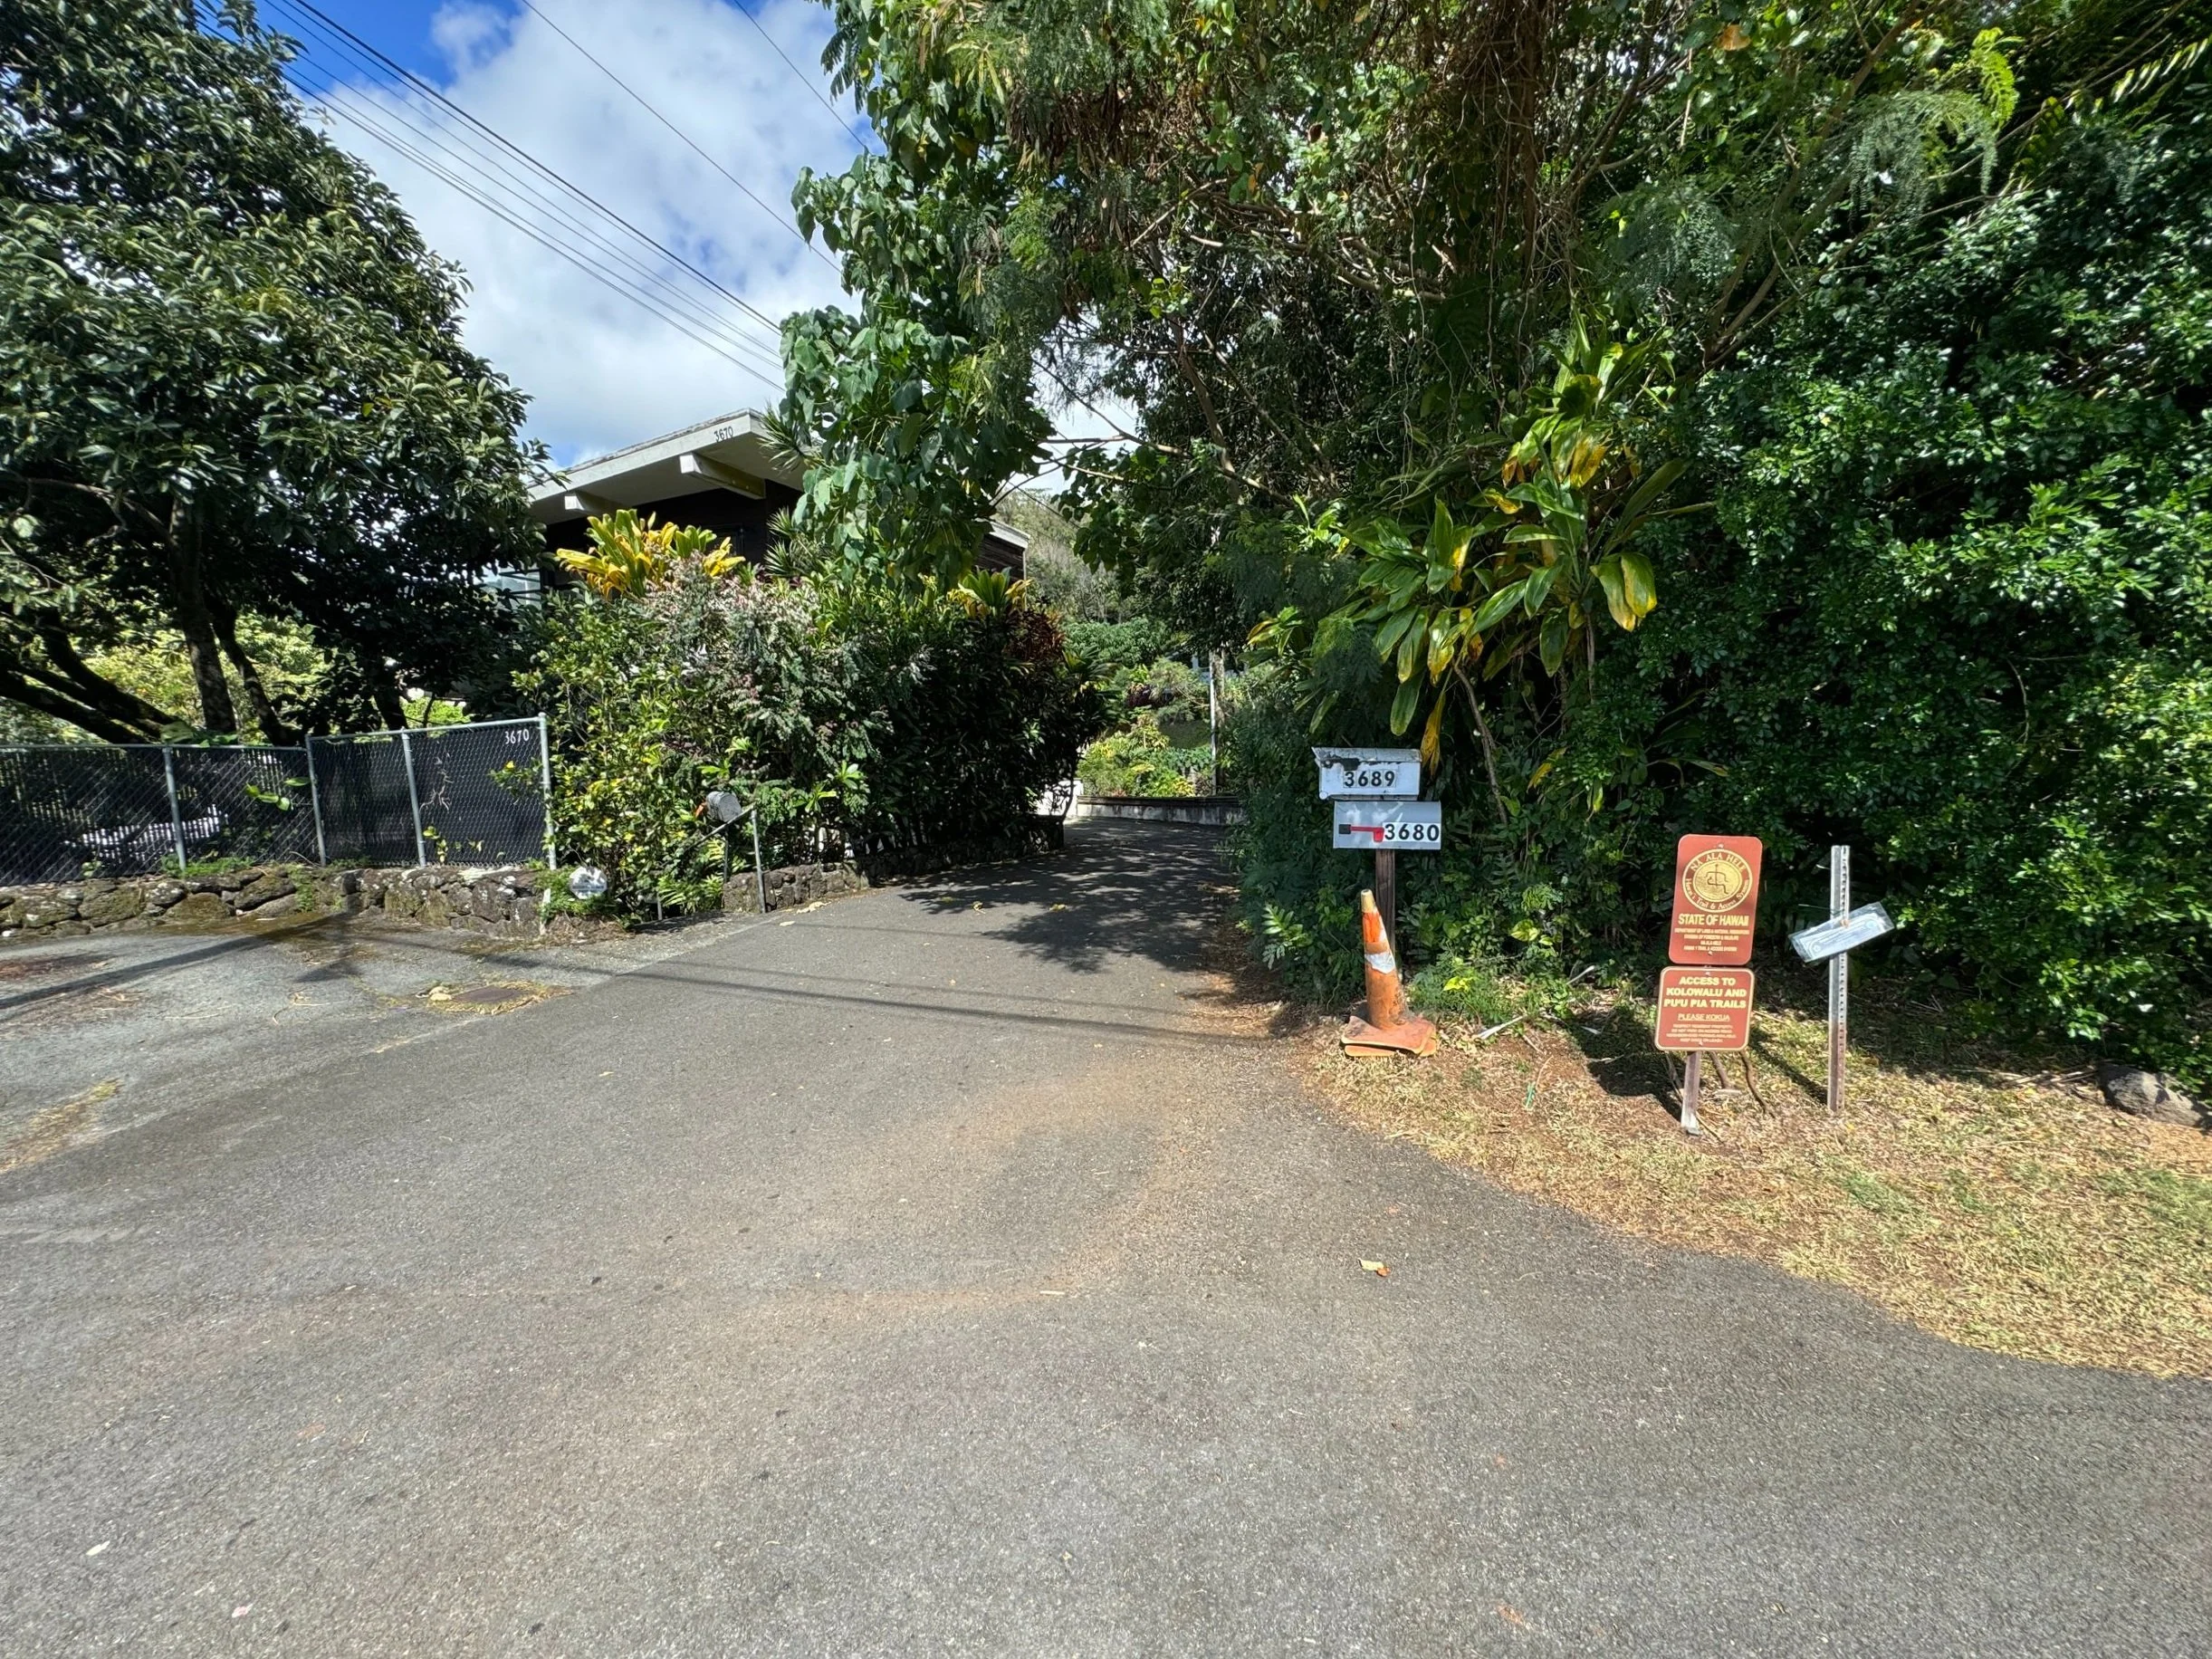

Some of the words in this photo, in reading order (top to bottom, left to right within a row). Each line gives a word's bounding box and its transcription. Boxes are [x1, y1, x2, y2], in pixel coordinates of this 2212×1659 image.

[713, 426, 733, 442] 3670
[504, 728, 530, 744] 3670
[1344, 771, 1395, 787] 3689
[1384, 823, 1440, 840] 3680
[1706, 852, 1723, 862] ALA
[1678, 913, 1705, 925] STATE
[1706, 915, 1719, 925] OF
[1719, 915, 1749, 926] HAWAII
[1679, 976, 1719, 985] ACCESS
[1721, 977, 1736, 986] TO
[1666, 987, 1723, 996] KOLOWALU
[1724, 988, 1748, 997] AND
[1690, 999, 1708, 1008] PIA
[1709, 1000, 1747, 1009] TRAILS
